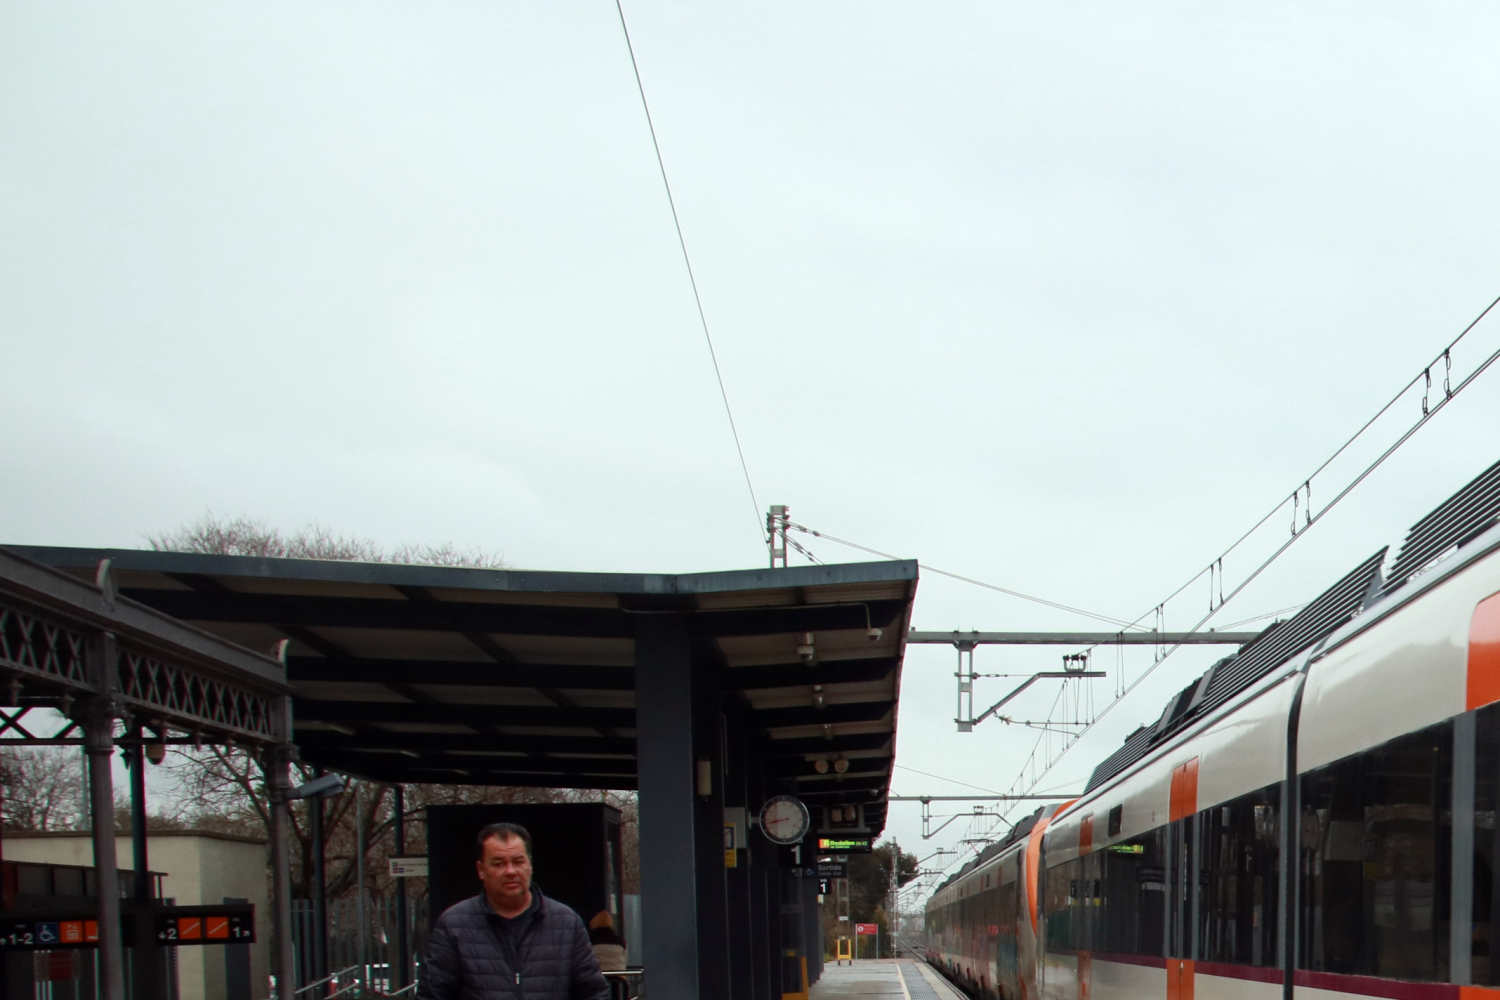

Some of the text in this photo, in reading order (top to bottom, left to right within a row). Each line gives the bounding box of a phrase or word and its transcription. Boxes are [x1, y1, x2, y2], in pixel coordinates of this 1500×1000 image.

[791, 845, 801, 865] 1
[820, 883, 827, 893] 1
[9, 932, 35, 945] 1-2
[167, 926, 241, 940] 2 1
